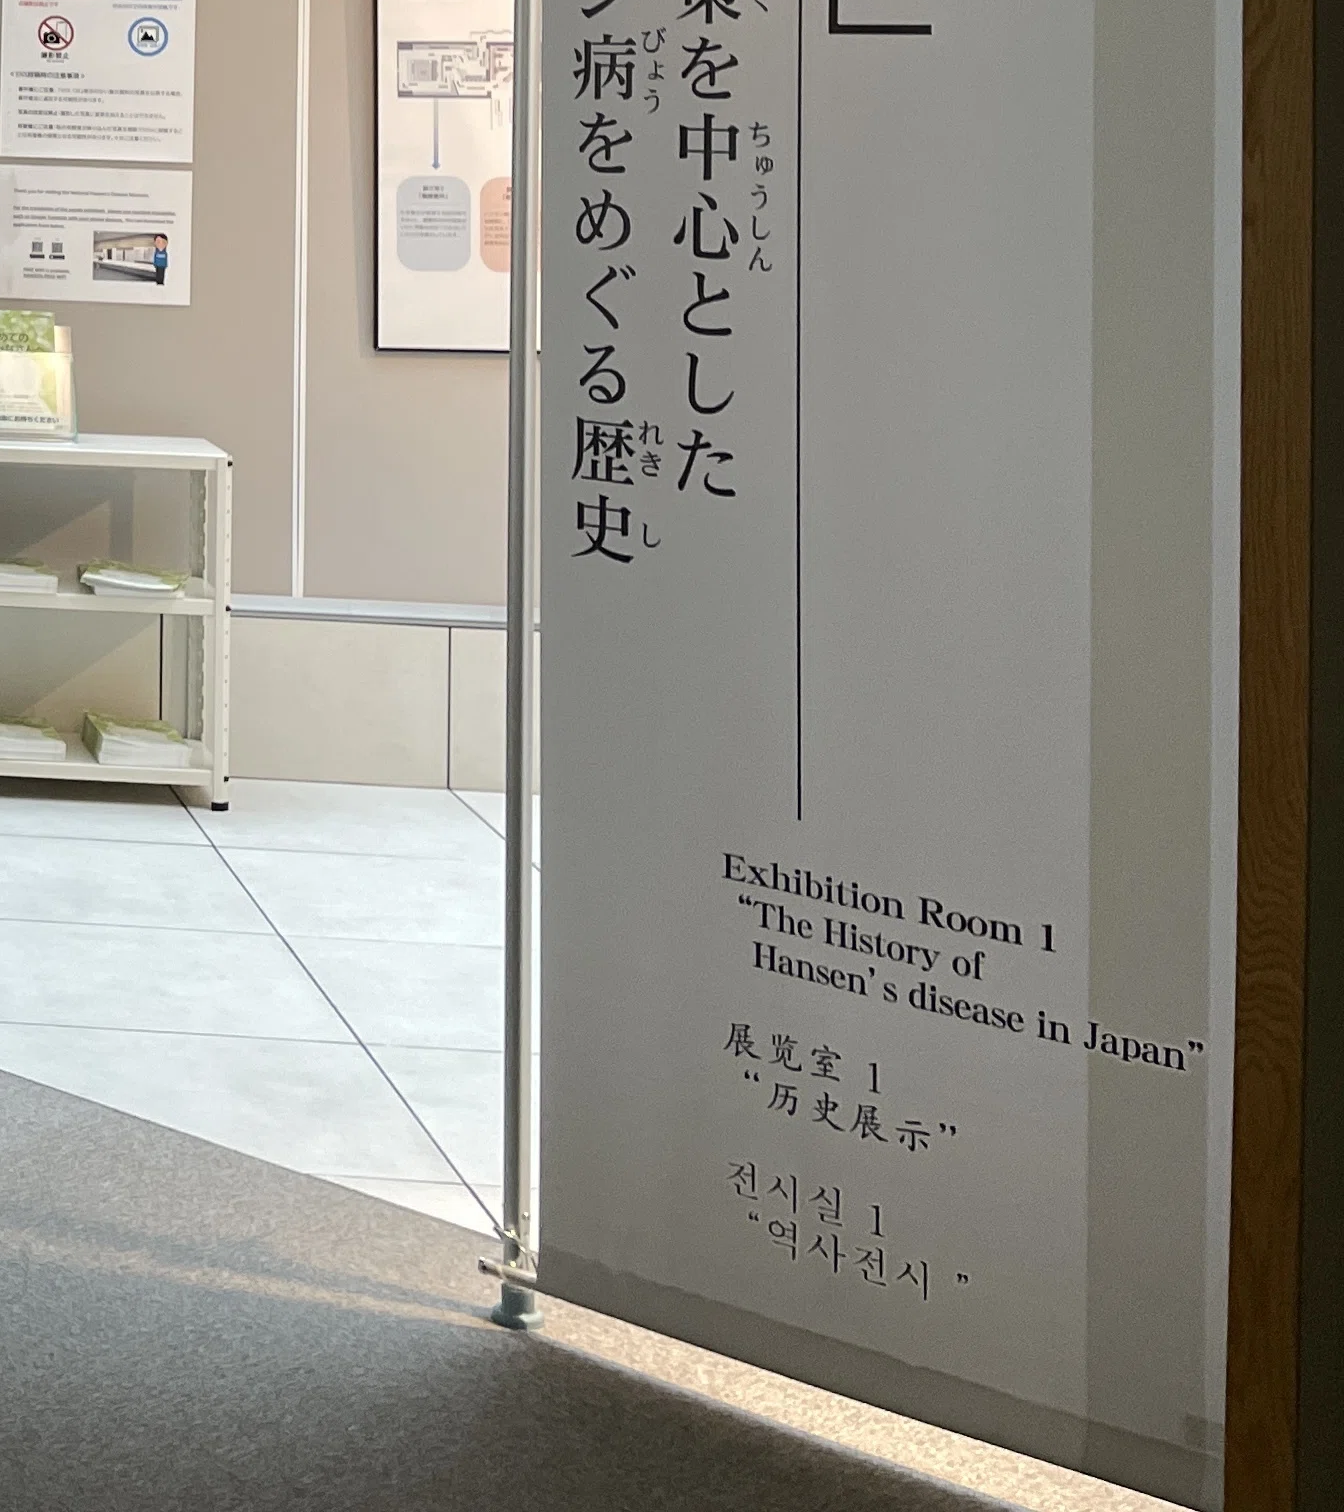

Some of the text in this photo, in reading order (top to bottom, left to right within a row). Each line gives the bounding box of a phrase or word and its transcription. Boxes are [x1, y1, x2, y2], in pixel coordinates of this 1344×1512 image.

[721, 851, 1057, 954] Exhibition Room 1
[822, 916, 941, 973] History
[951, 951, 987, 981] of
[908, 982, 1026, 1033] disease
[1036, 1010, 1072, 1045] in
[722, 1021, 883, 1094] 展览室 1
[725, 1160, 885, 1238] 전시실 1
